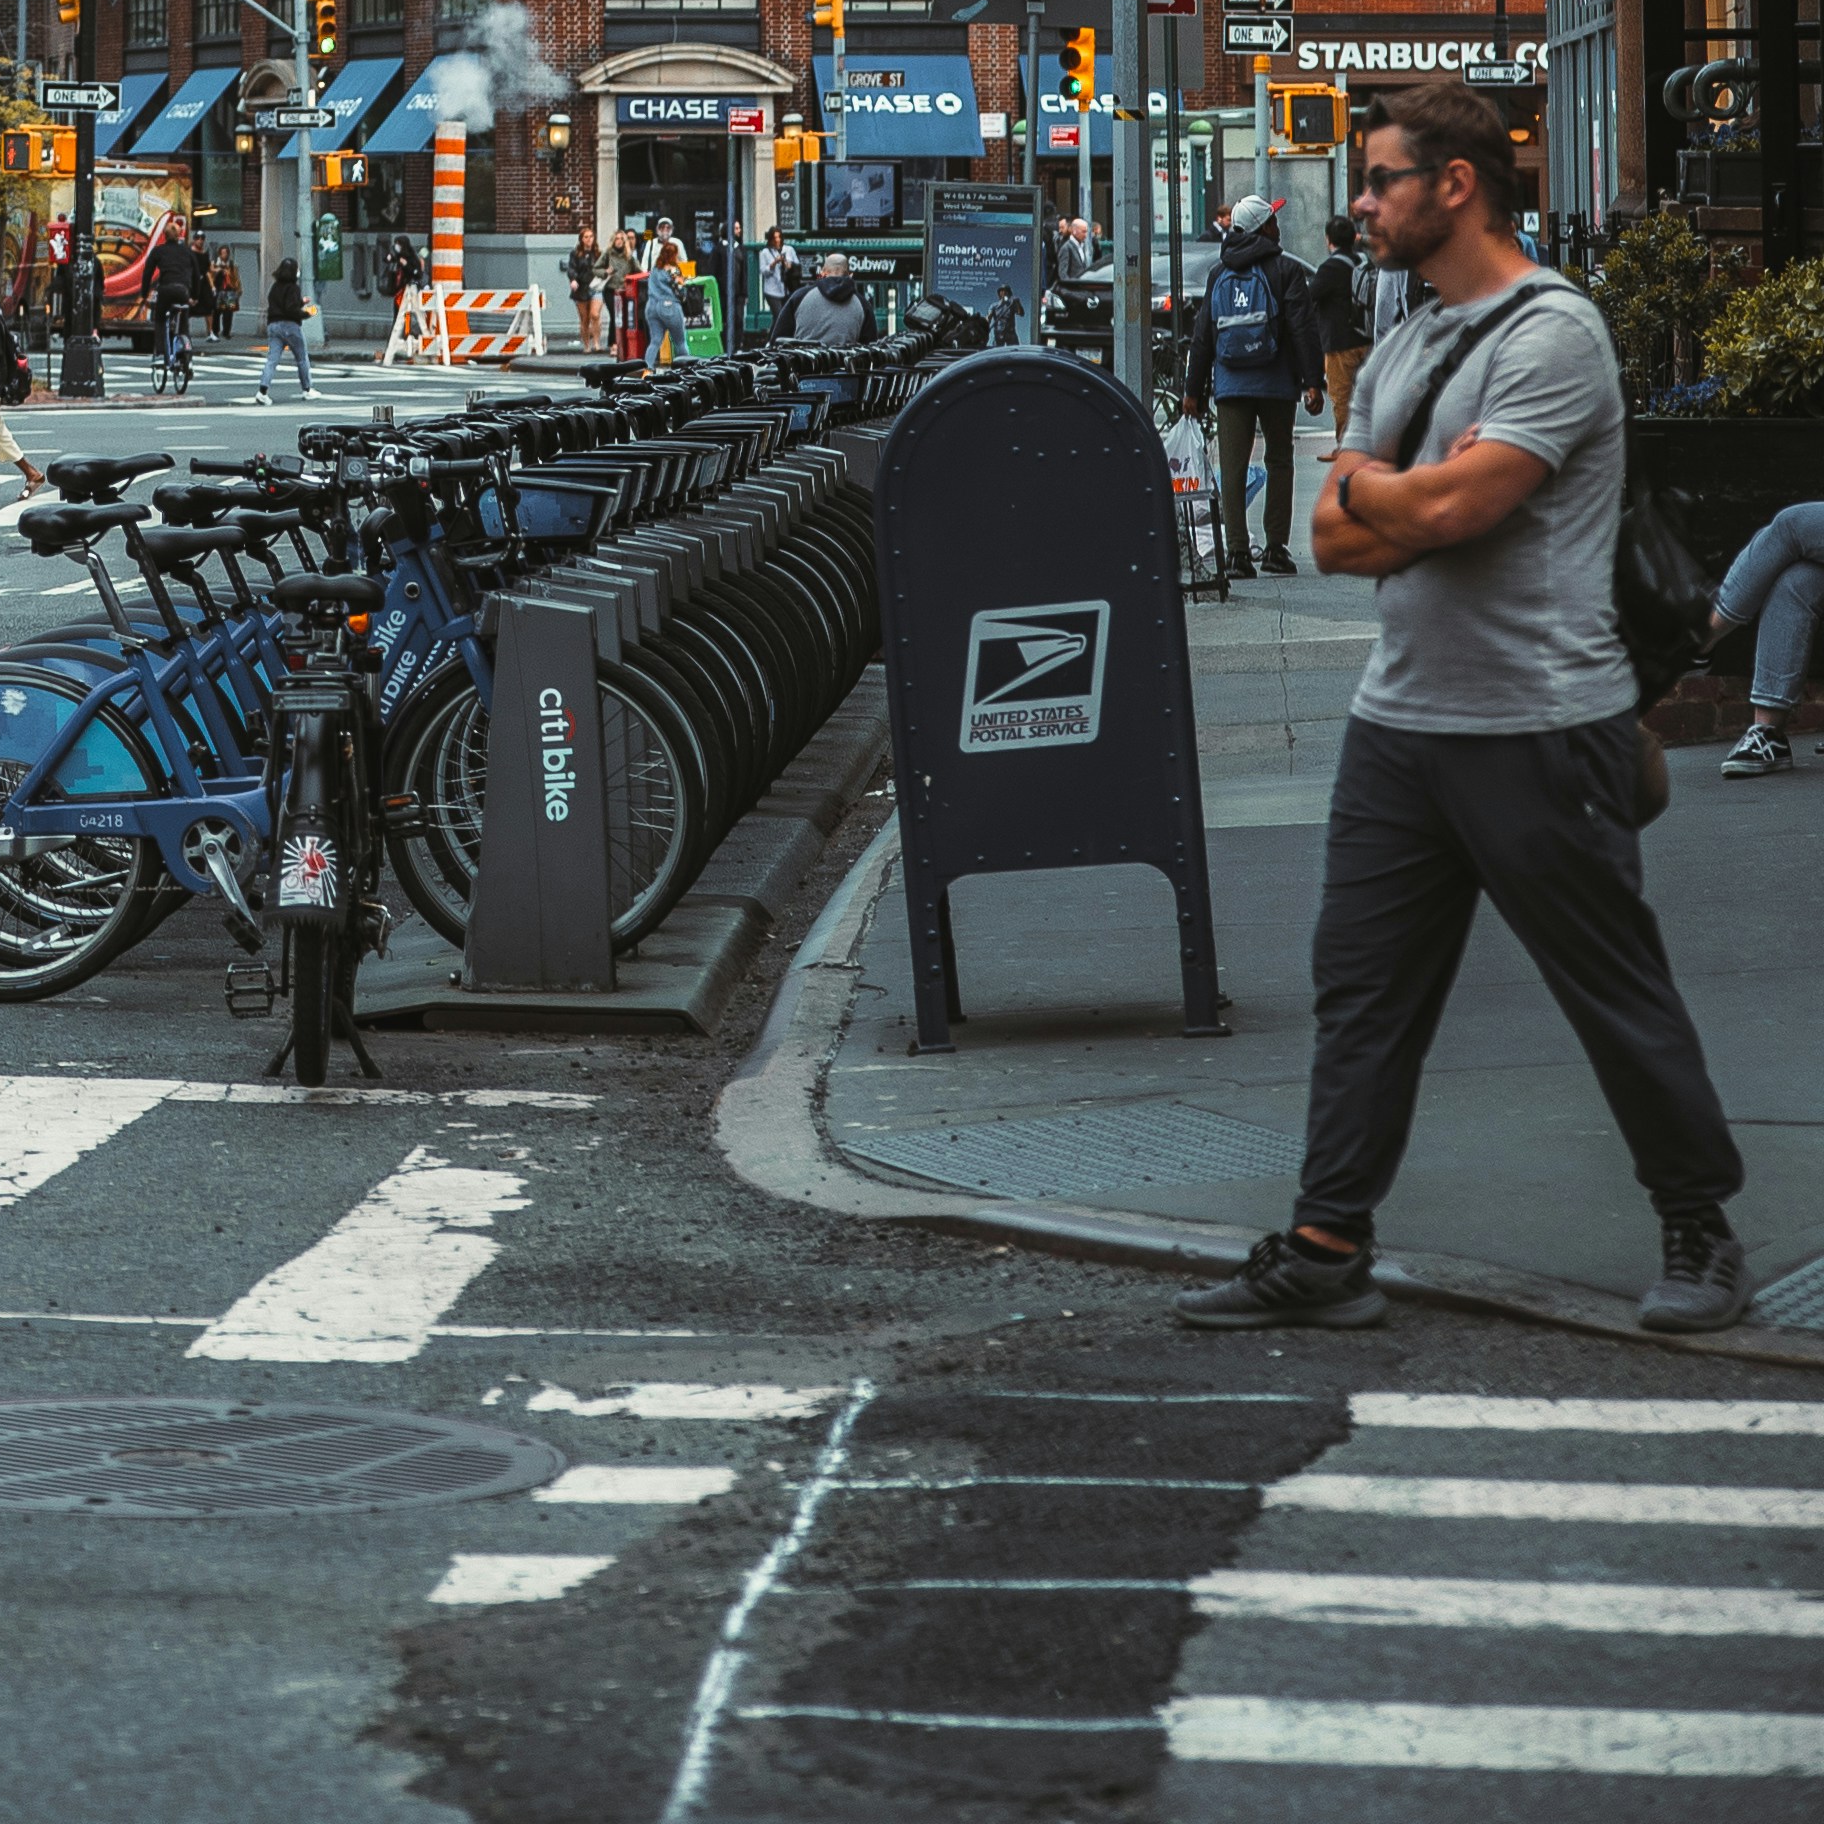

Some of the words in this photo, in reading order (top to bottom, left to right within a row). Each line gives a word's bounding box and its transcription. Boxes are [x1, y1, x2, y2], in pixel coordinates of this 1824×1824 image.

[1233, 26, 1254, 41] ONE
[1262, 25, 1283, 41] WAY
[849, 72, 884, 87] GROVE
[889, 72, 903, 87] ST
[1474, 67, 1494, 80] ONE
[1503, 67, 1523, 79] WAY
[53, 90, 76, 102] ONE
[86, 90, 109, 102] WAY
[629, 98, 719, 120] CHASE
[555, 195, 571, 209] 74
[938, 243, 978, 256] Embark
[980, 246, 994, 256] on
[995, 246, 1018, 258] your
[848, 255, 896, 275] Subway
[937, 256, 959, 267] next
[1234, 286, 1248, 307] LA
[538, 687, 570, 743] citi
[970, 709, 1029, 727] UNITED
[1031, 704, 1084, 723] STATES
[969, 726, 1026, 744] POSTAL
[1028, 721, 1089, 739] SERVICE
[541, 747, 576, 823] bike
[79, 813, 124, 829] 04218
